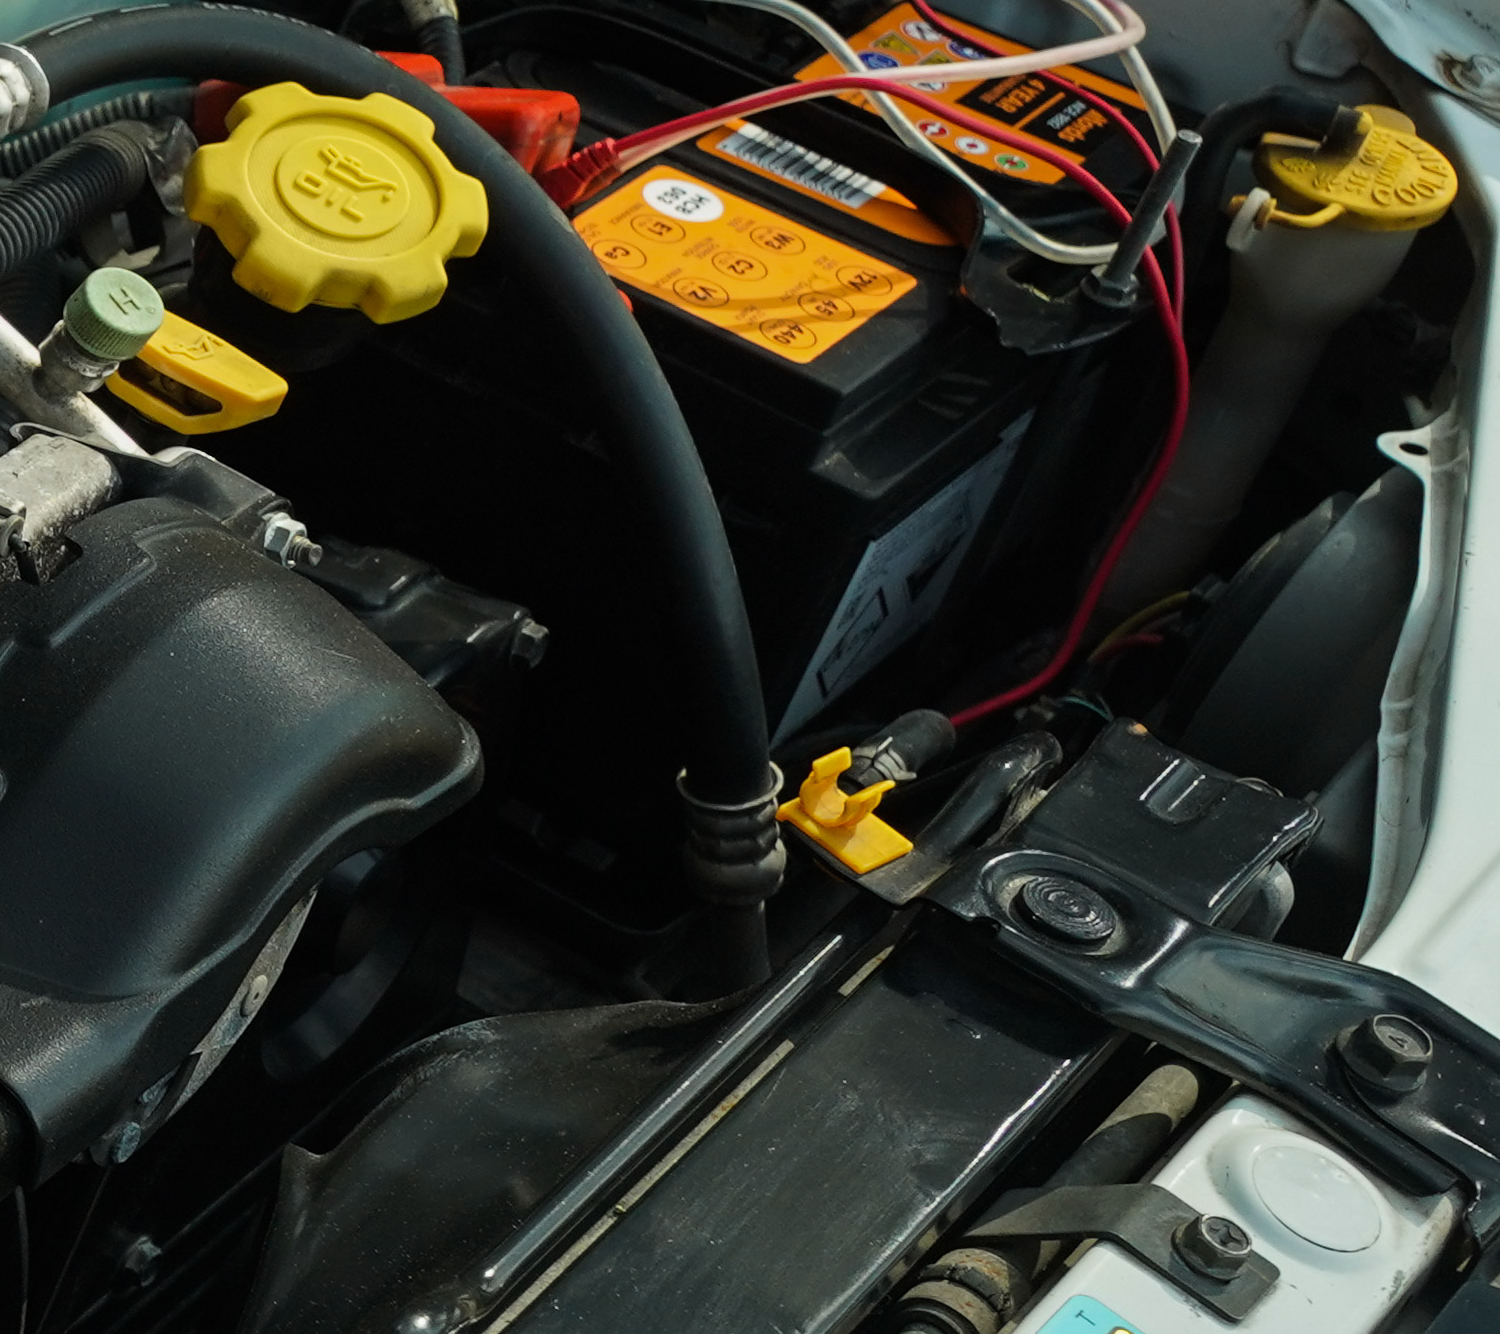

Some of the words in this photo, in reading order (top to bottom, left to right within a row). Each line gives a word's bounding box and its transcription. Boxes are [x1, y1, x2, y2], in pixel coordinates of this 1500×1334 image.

[1371, 139, 1448, 207] COOLANT
[293, 172, 365, 224] OIL
[644, 219, 674, 238] E1
[724, 256, 757, 278] C2
[843, 268, 880, 292] 12V
[685, 281, 721, 306] V2
[811, 297, 844, 319] 45
[769, 320, 809, 348] 440
[1073, 1307, 1099, 1330] T
